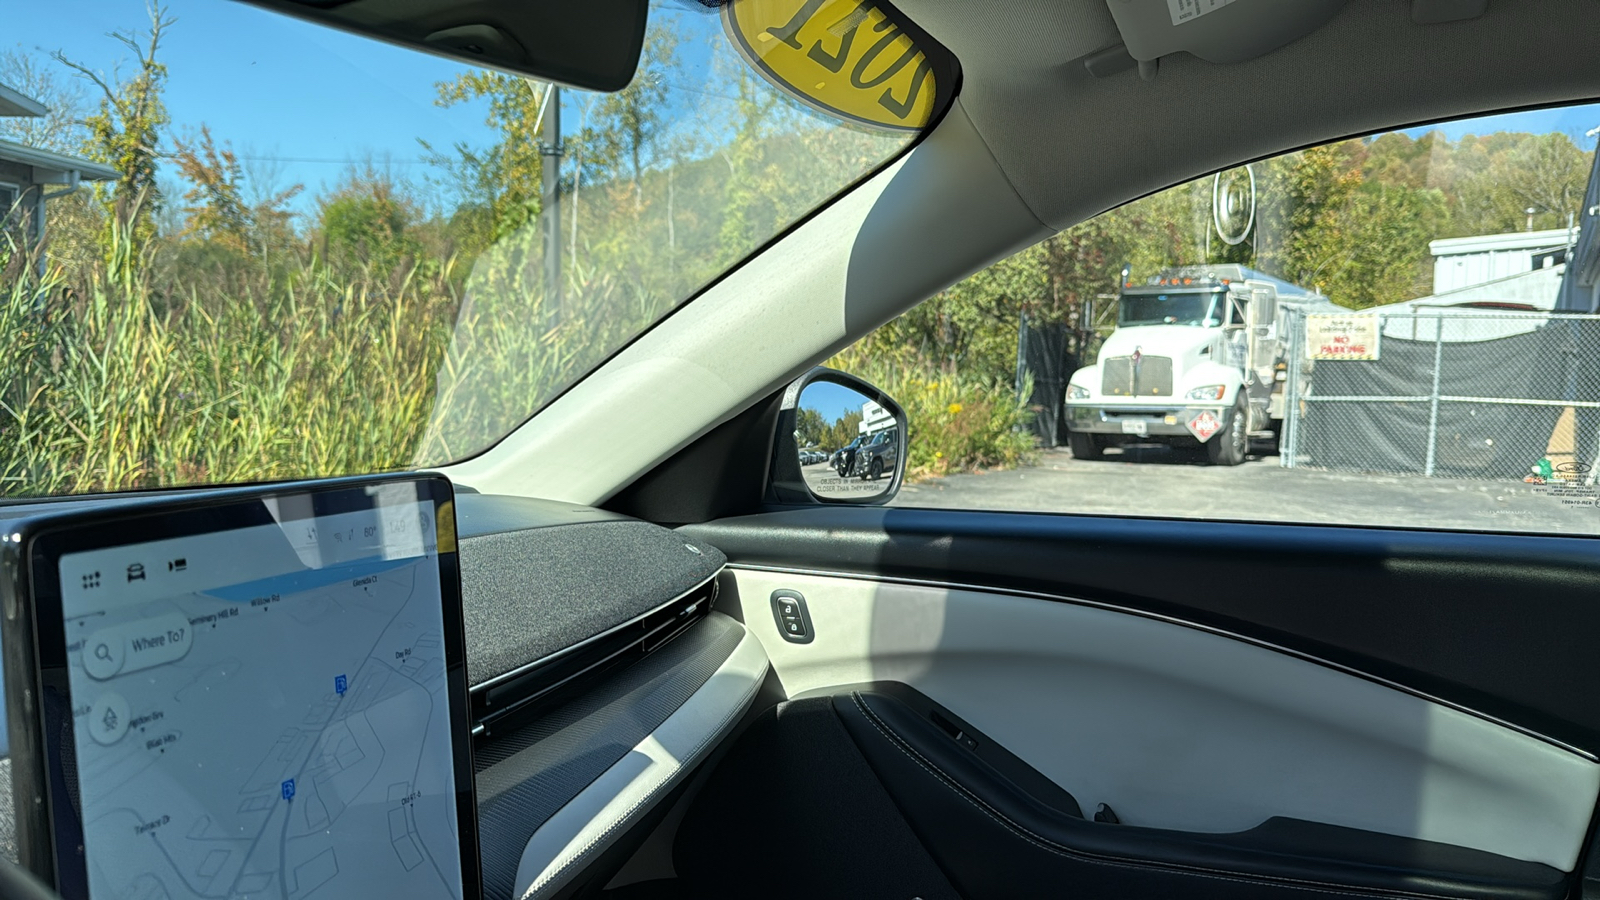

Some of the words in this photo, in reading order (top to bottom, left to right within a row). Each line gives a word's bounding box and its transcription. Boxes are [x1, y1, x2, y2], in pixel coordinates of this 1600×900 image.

[1333, 335, 1350, 344] NO
[1320, 345, 1367, 354] PARKING
[229, 607, 239, 617] Rd
[131, 635, 165, 653] Where
[167, 628, 185, 644] To?
